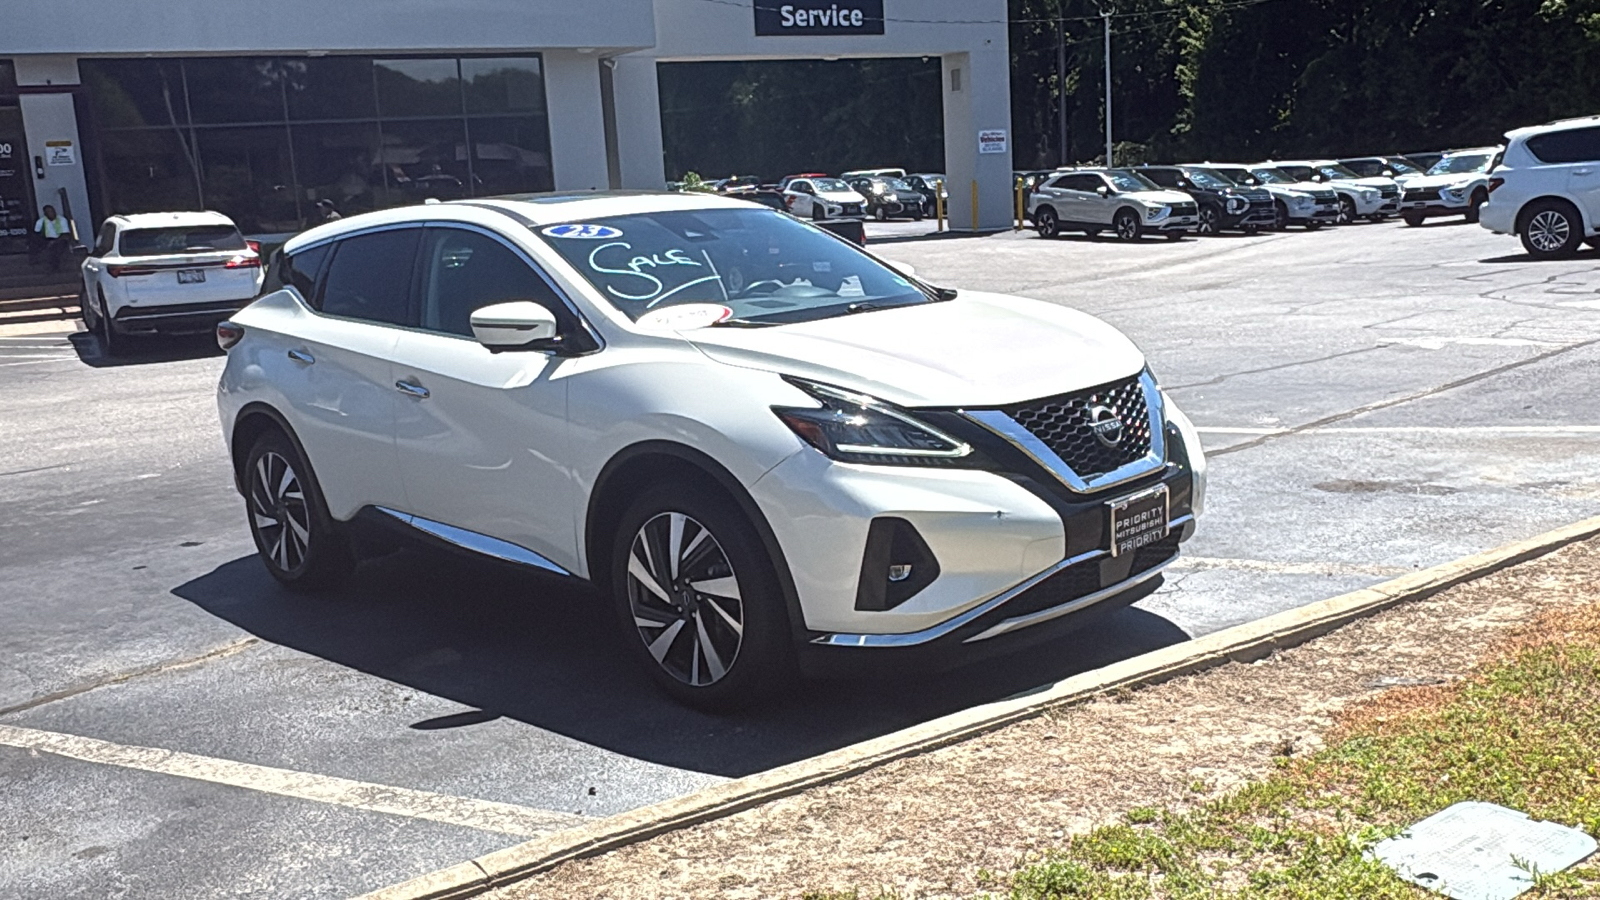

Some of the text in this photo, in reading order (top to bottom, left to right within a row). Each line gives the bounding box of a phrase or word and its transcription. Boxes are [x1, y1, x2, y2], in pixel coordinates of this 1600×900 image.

[780, 4, 863, 27] Service
[561, 224, 602, 238] 23
[1116, 505, 1163, 531] PRIORITY
[1116, 516, 1163, 540] MITSUBISHI
[1120, 528, 1163, 554] PRIORITY
